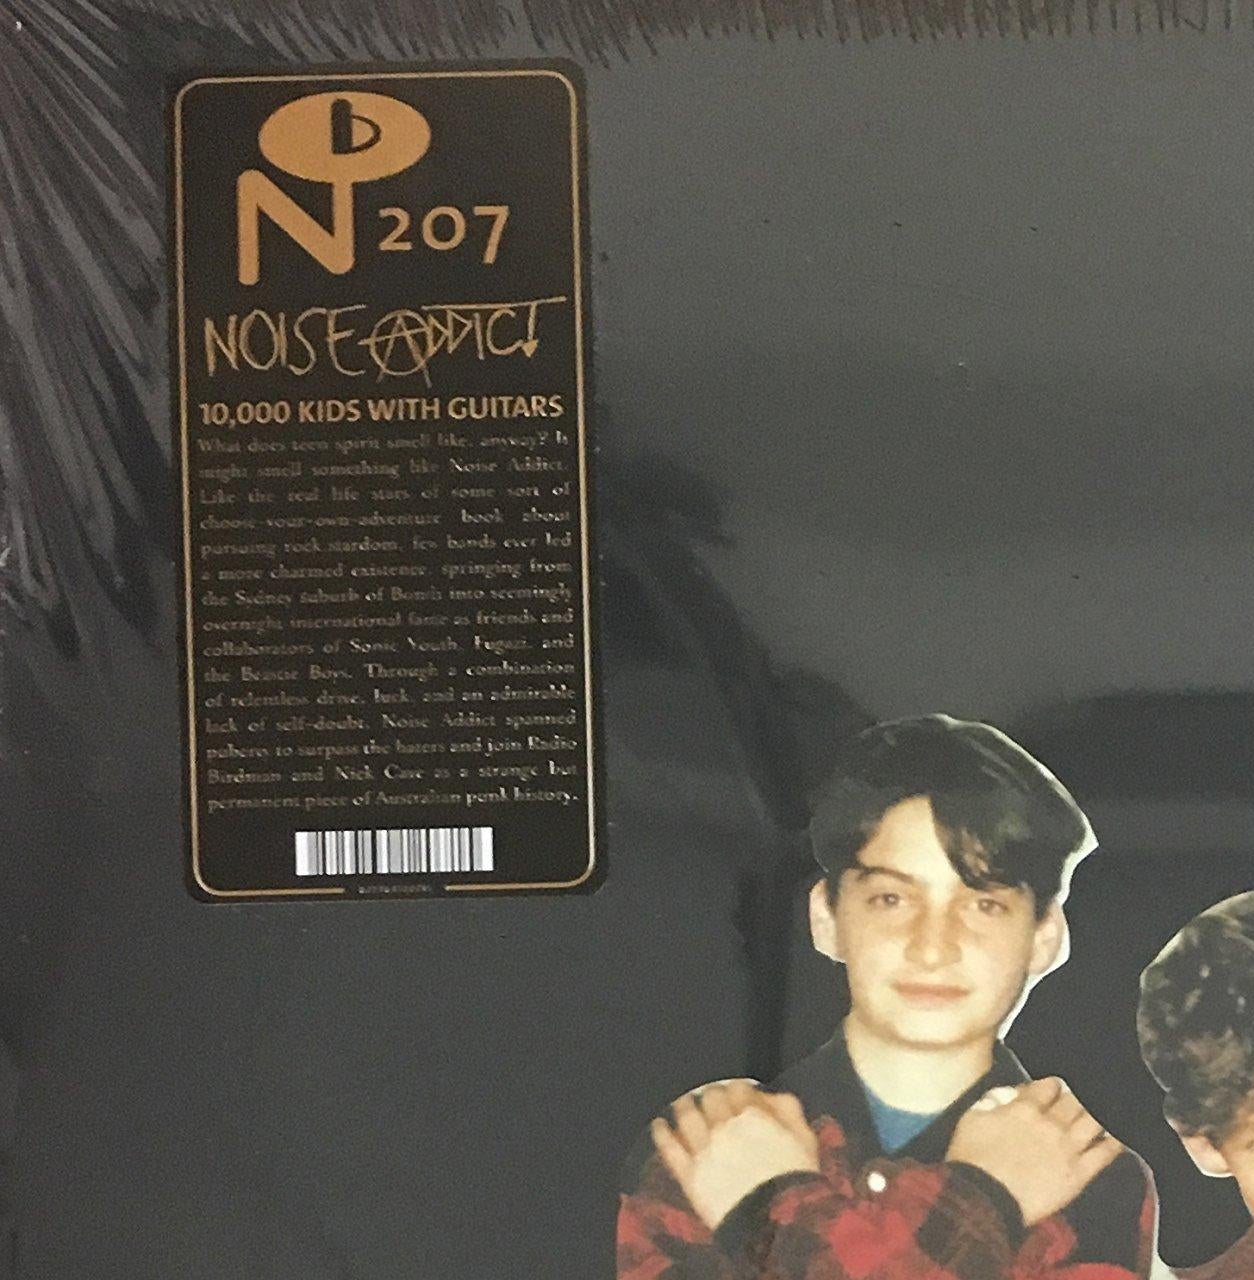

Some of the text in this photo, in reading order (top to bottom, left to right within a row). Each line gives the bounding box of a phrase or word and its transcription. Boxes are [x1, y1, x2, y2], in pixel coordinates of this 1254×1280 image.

[378, 204, 510, 264] 207
[203, 304, 367, 377] NOISE
[199, 395, 564, 427] 10,000 KIDS WITH GUITARS
